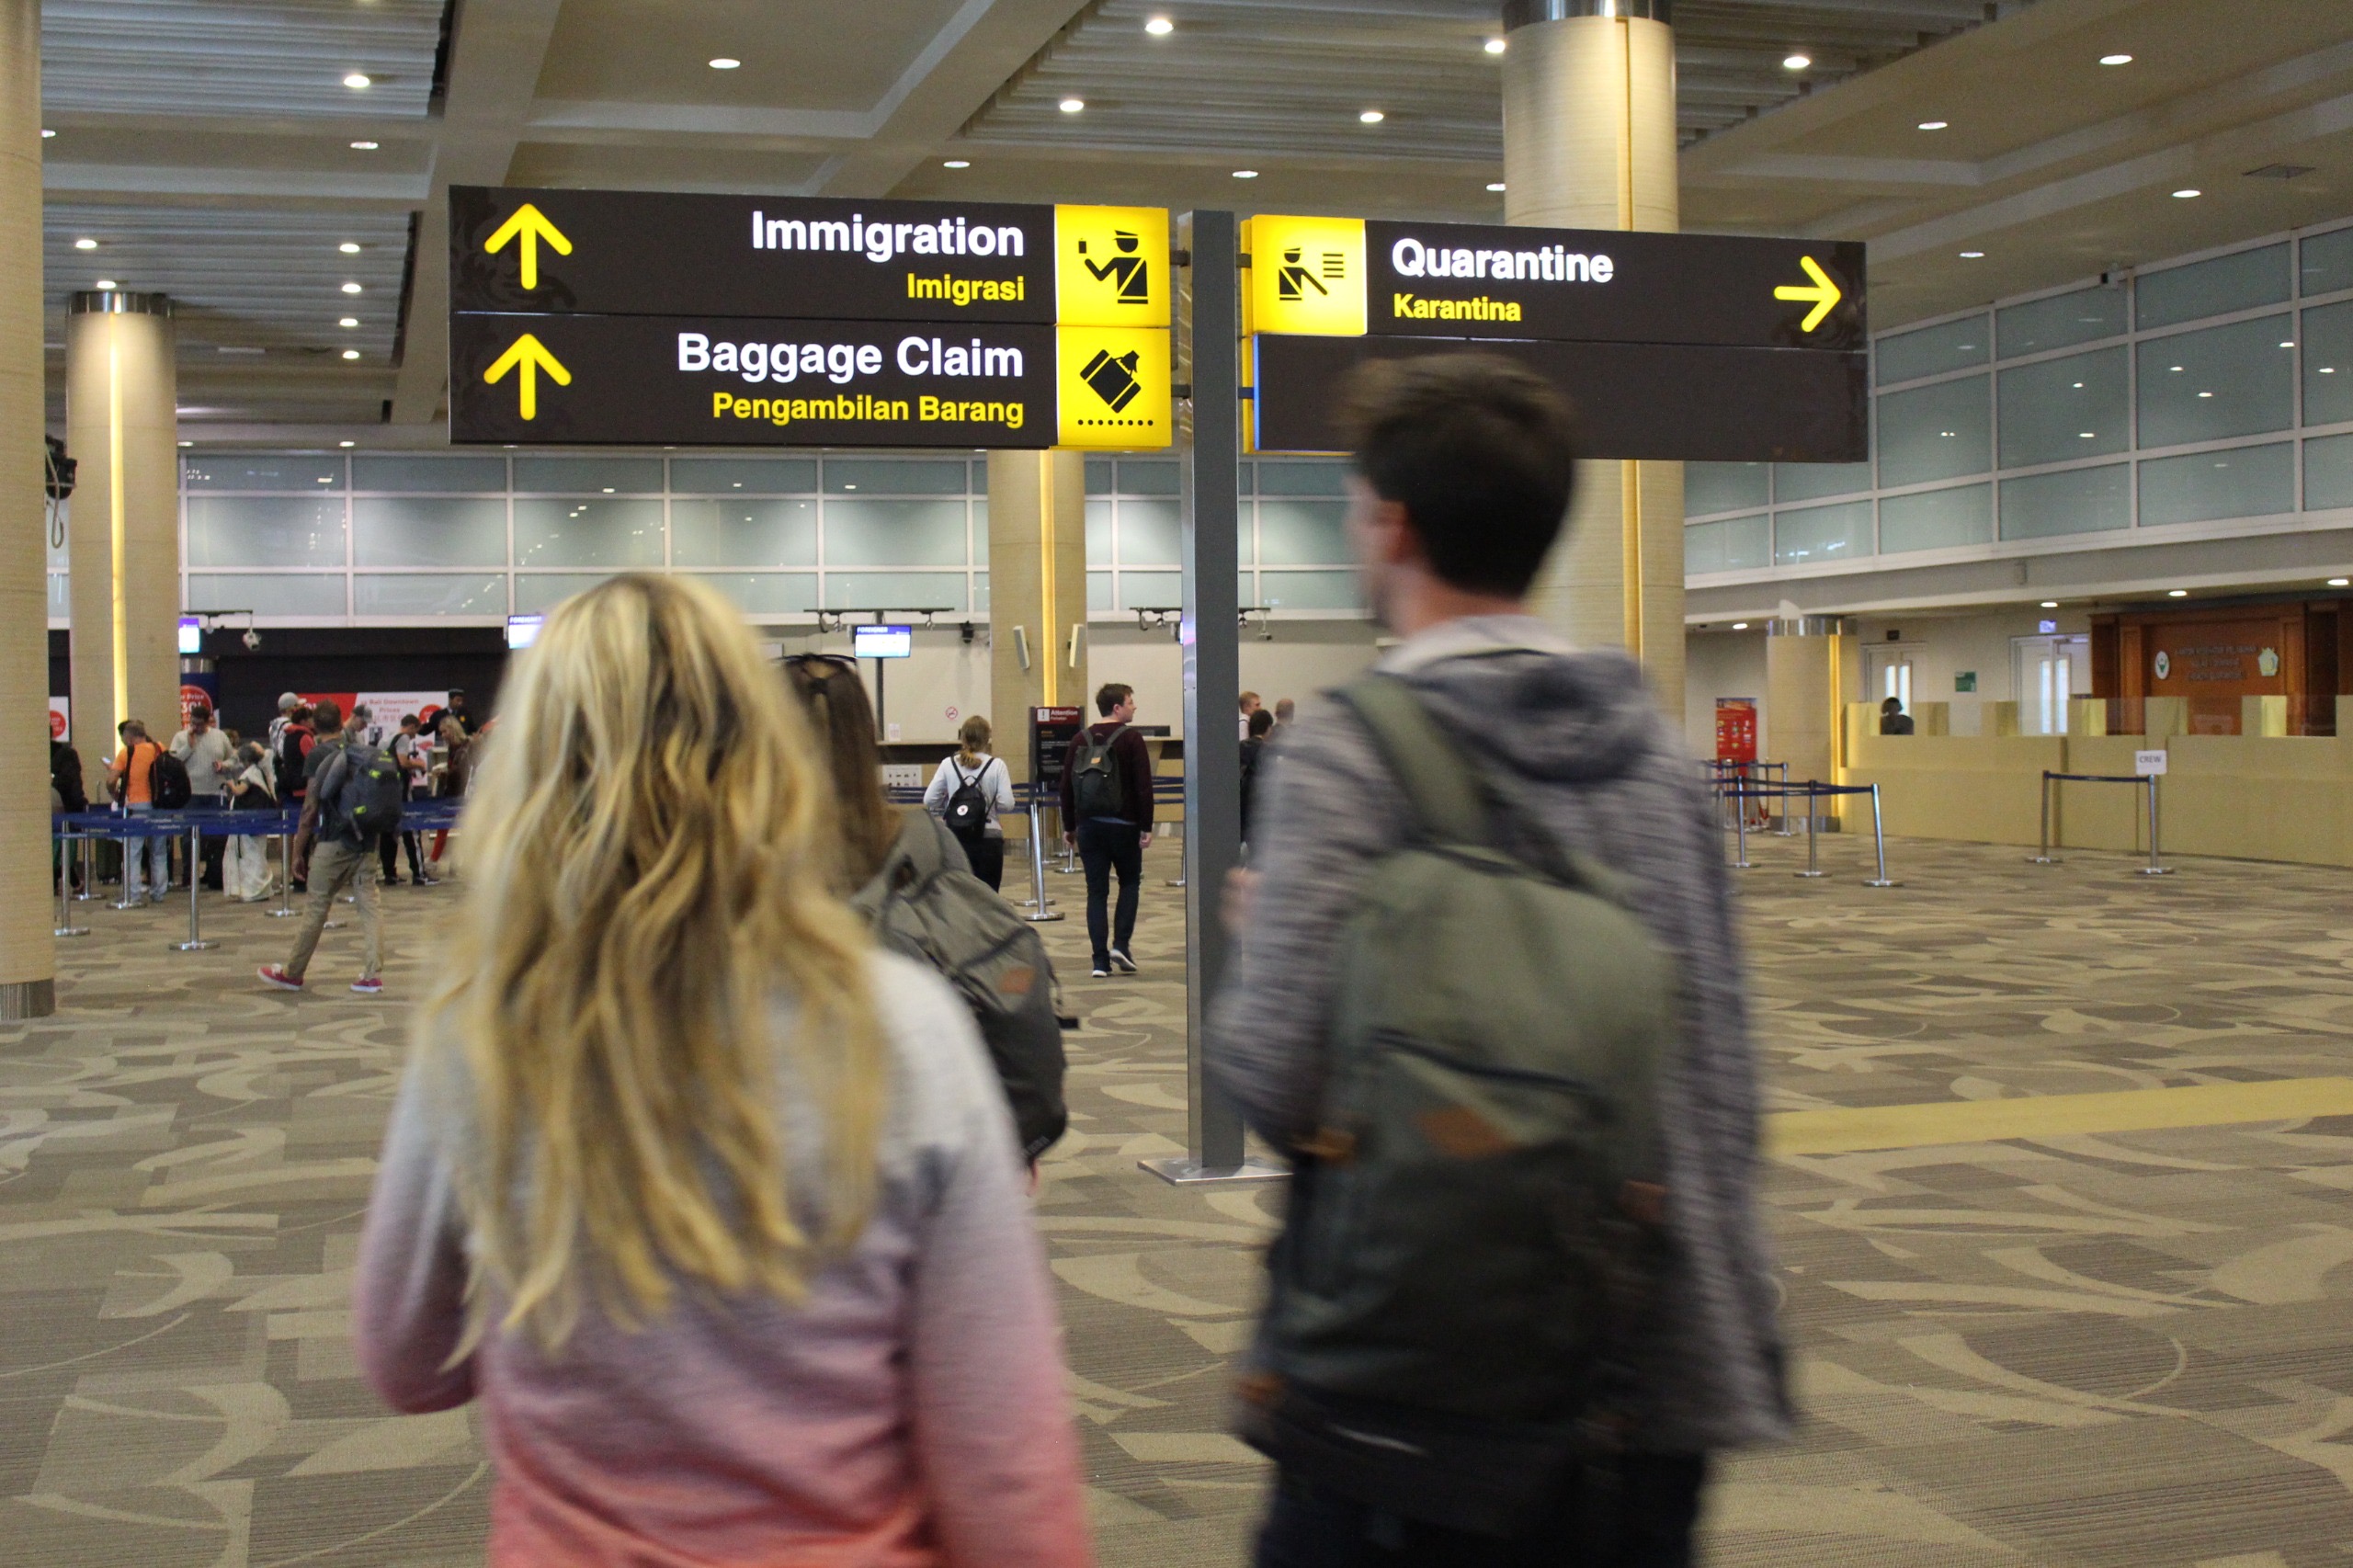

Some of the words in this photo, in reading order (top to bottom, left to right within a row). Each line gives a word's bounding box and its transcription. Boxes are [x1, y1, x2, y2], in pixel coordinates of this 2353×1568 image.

[752, 210, 1025, 263] Immigration
[1392, 236, 1615, 284] Quarantine
[907, 272, 1025, 307] Imigrasi
[1393, 292, 1522, 322] Karantina
[677, 332, 882, 384] Baggage
[896, 337, 1024, 379] Claim
[713, 392, 909, 426] Pengambilan
[918, 395, 1024, 429] Barang
